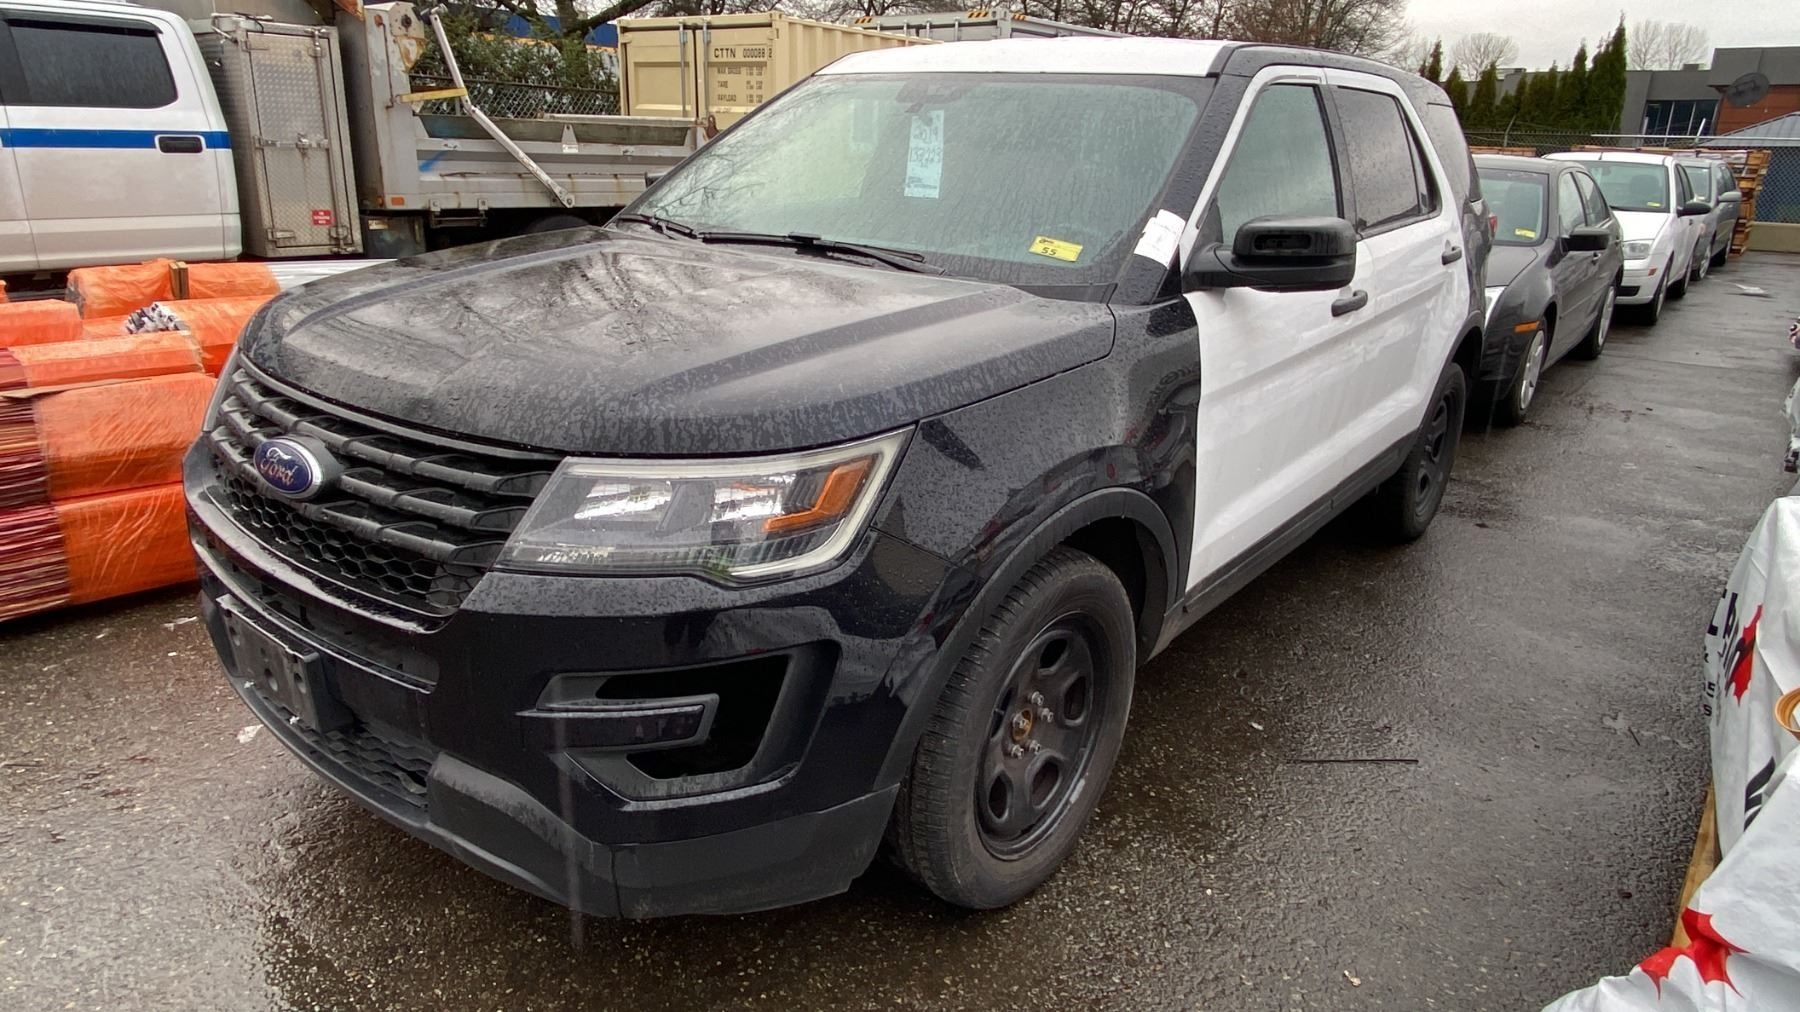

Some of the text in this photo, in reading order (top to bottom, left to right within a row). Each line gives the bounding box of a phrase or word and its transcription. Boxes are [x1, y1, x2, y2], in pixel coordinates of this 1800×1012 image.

[714, 48, 773, 58] CTTN 000088 2
[717, 80, 728, 88] TARE
[717, 94, 737, 102] PAYLOAD
[1041, 246, 1058, 256] 55
[261, 447, 298, 485] Ford
